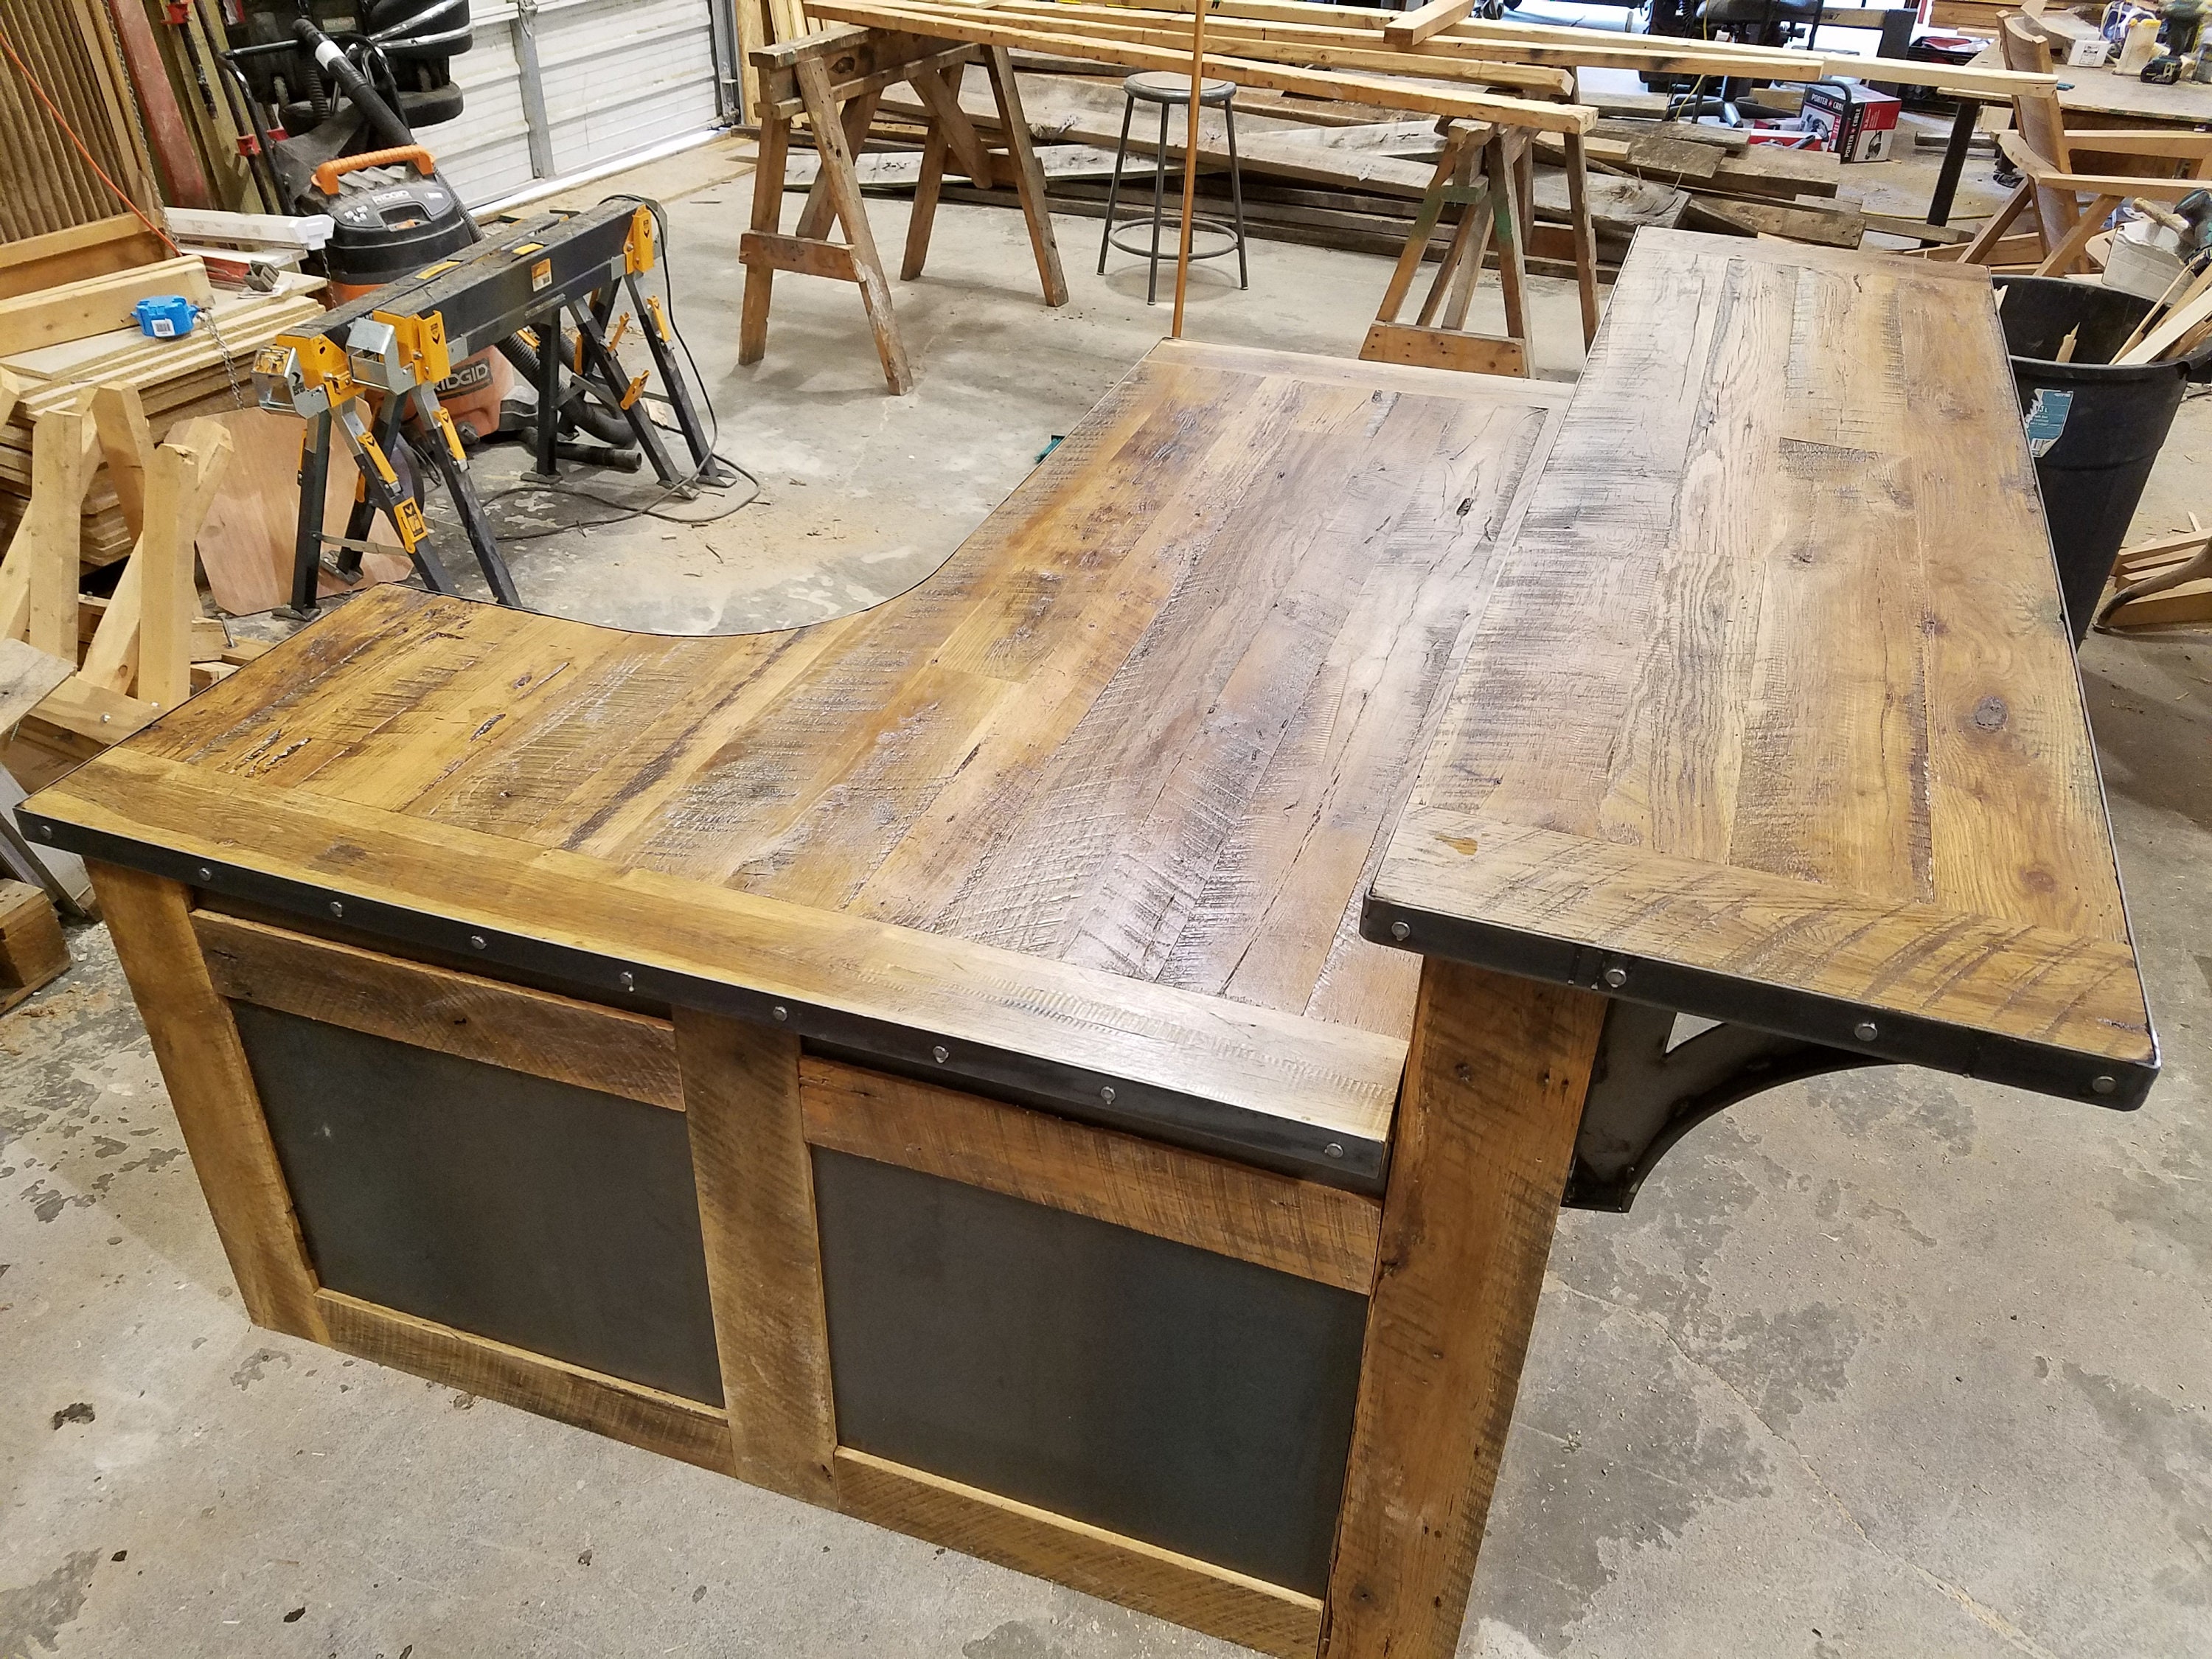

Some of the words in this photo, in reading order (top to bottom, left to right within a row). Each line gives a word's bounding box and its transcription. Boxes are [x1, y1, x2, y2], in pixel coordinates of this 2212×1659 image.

[1811, 93, 1829, 106] PORTER
[1844, 134, 1855, 158] PORTER
[1852, 107, 1862, 127] CABLE
[372, 189, 413, 206] RIDGID
